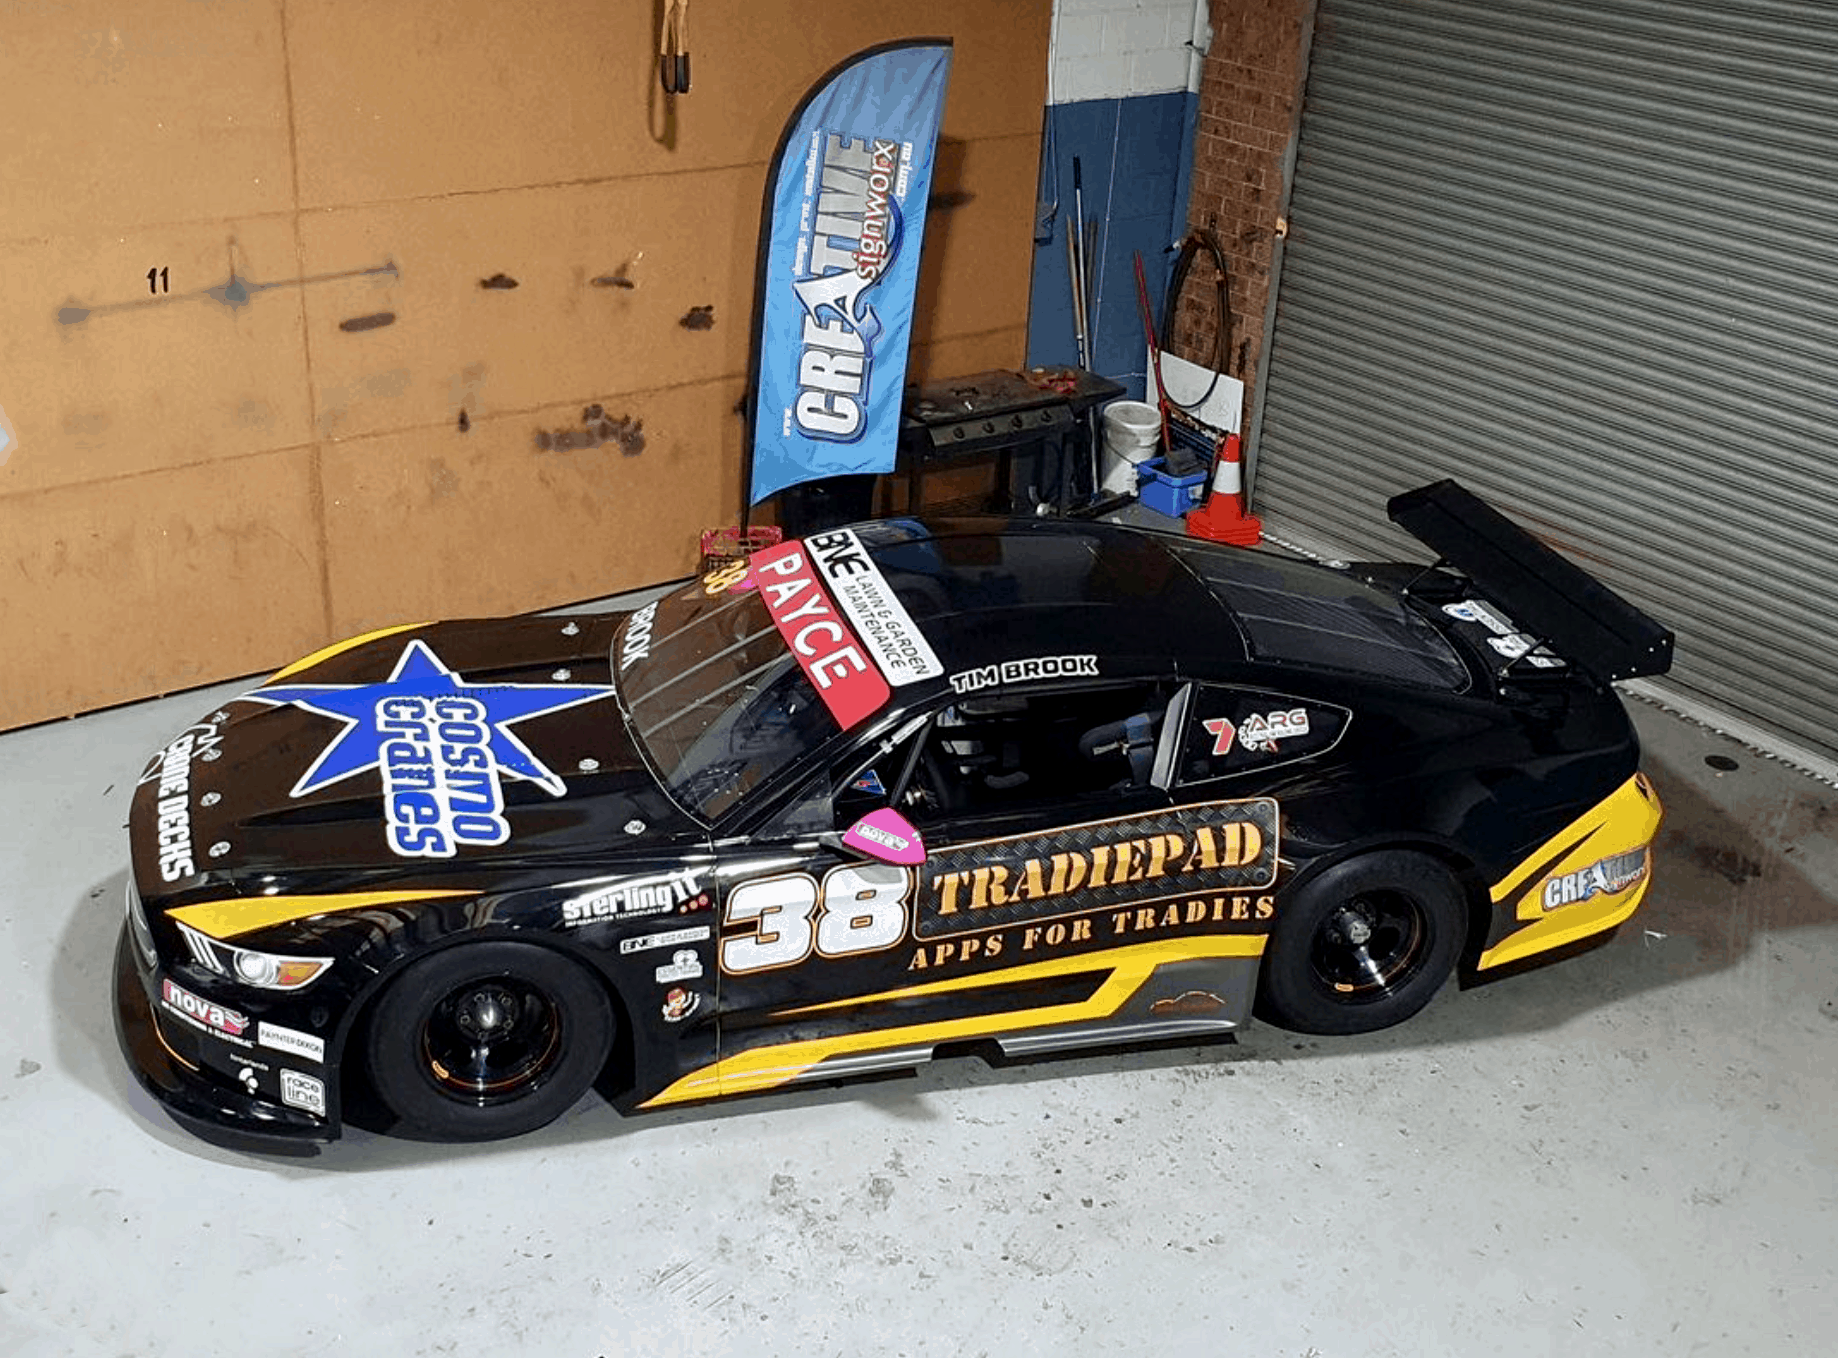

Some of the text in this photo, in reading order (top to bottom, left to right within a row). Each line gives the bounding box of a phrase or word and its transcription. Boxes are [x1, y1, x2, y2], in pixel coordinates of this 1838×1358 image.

[853, 140, 895, 279] signworx
[147, 266, 168, 294] 11
[794, 134, 885, 434] CREATIVE
[811, 532, 871, 578] BNE
[759, 552, 867, 689] PAYCE
[843, 585, 907, 669] MAINTENANCE
[856, 575, 887, 608] LAWN
[885, 621, 931, 675] GARDEN
[951, 655, 1099, 693] TIM BROOK
[1248, 709, 1308, 733] ARG
[932, 821, 1263, 916] TRADIEPAD
[721, 863, 911, 974] 38
[908, 896, 1275, 970] APPS FOR TRADIES
[169, 986, 226, 1027] nova
[286, 1077, 320, 1094] race
[288, 1086, 321, 1107] line
